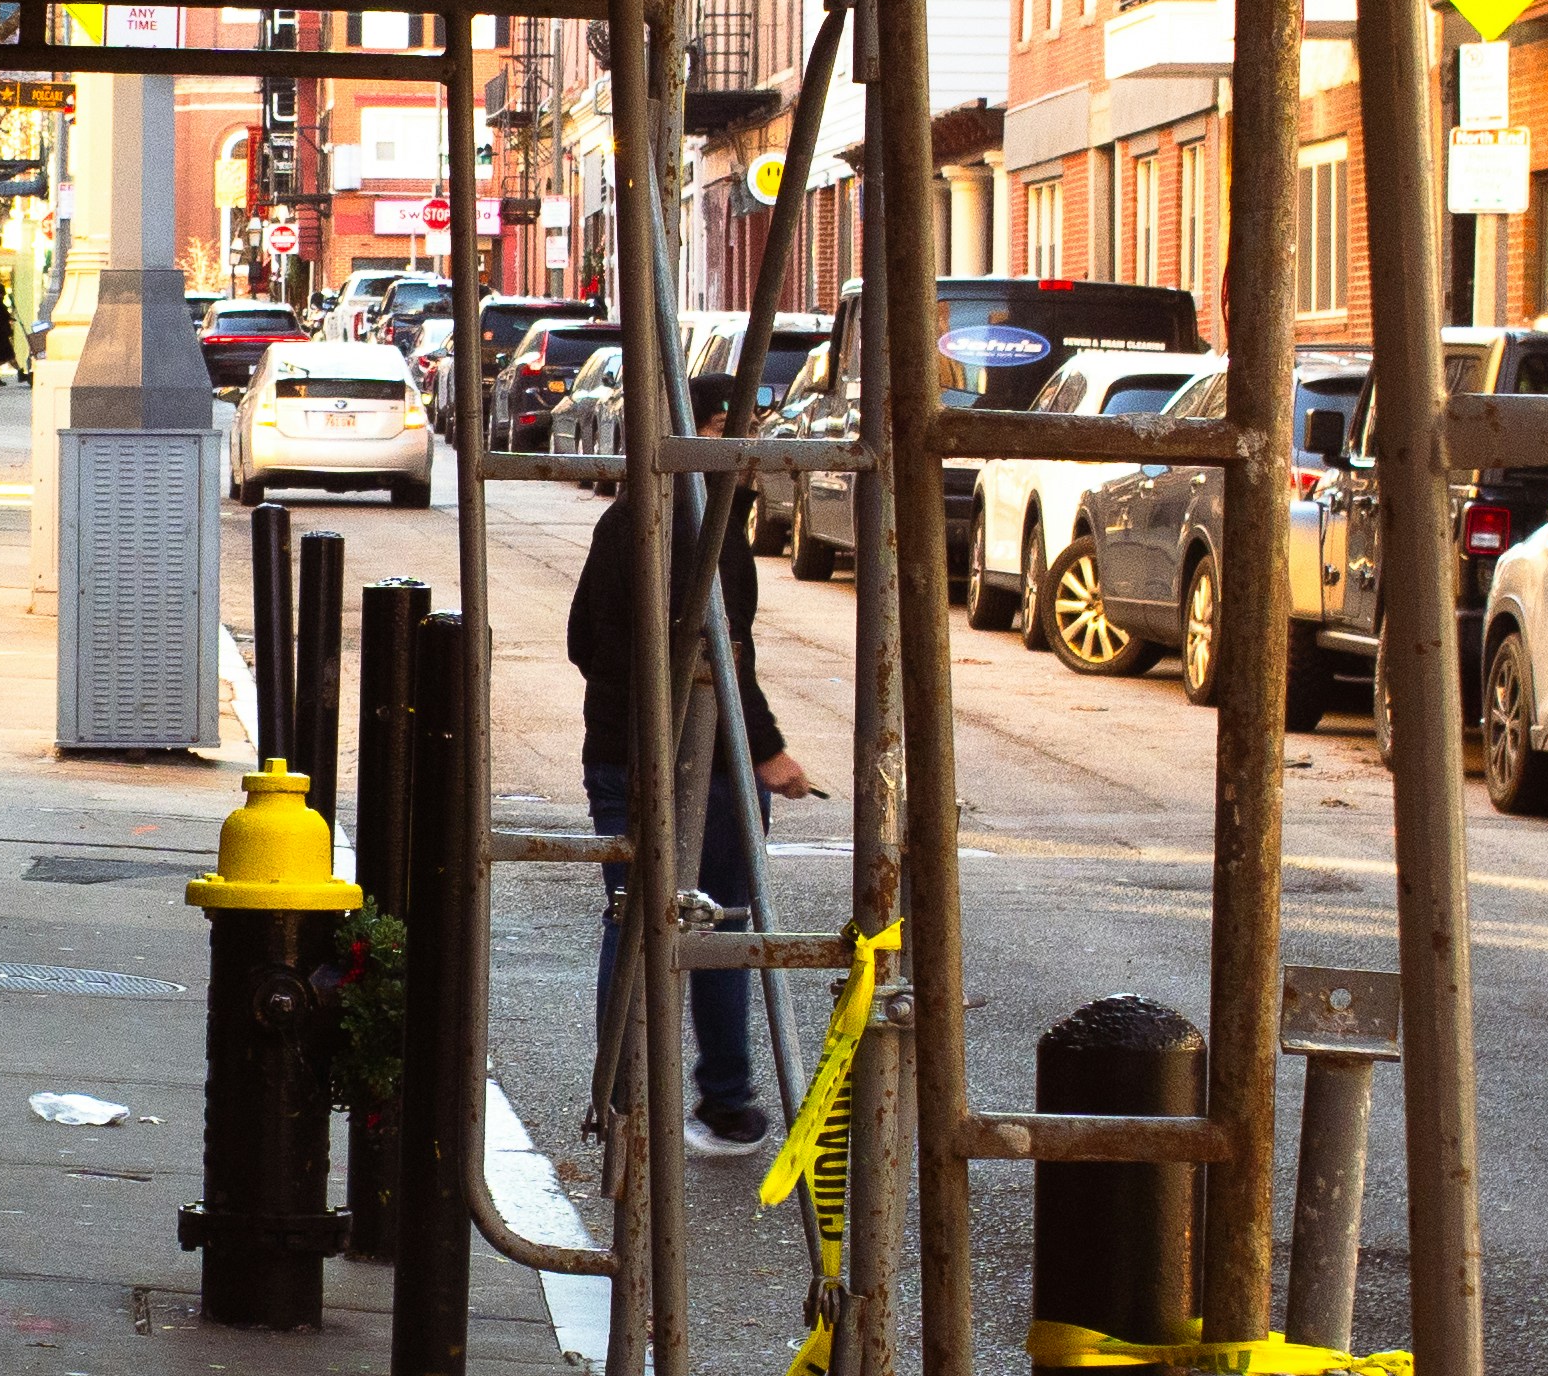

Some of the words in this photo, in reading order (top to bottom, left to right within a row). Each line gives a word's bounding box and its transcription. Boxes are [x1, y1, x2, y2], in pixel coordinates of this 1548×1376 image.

[129, 8, 155, 18] ANY
[127, 20, 157, 31] TIME
[1456, 131, 1495, 145] North
[1497, 130, 1525, 145] End
[423, 208, 451, 222] STOP
